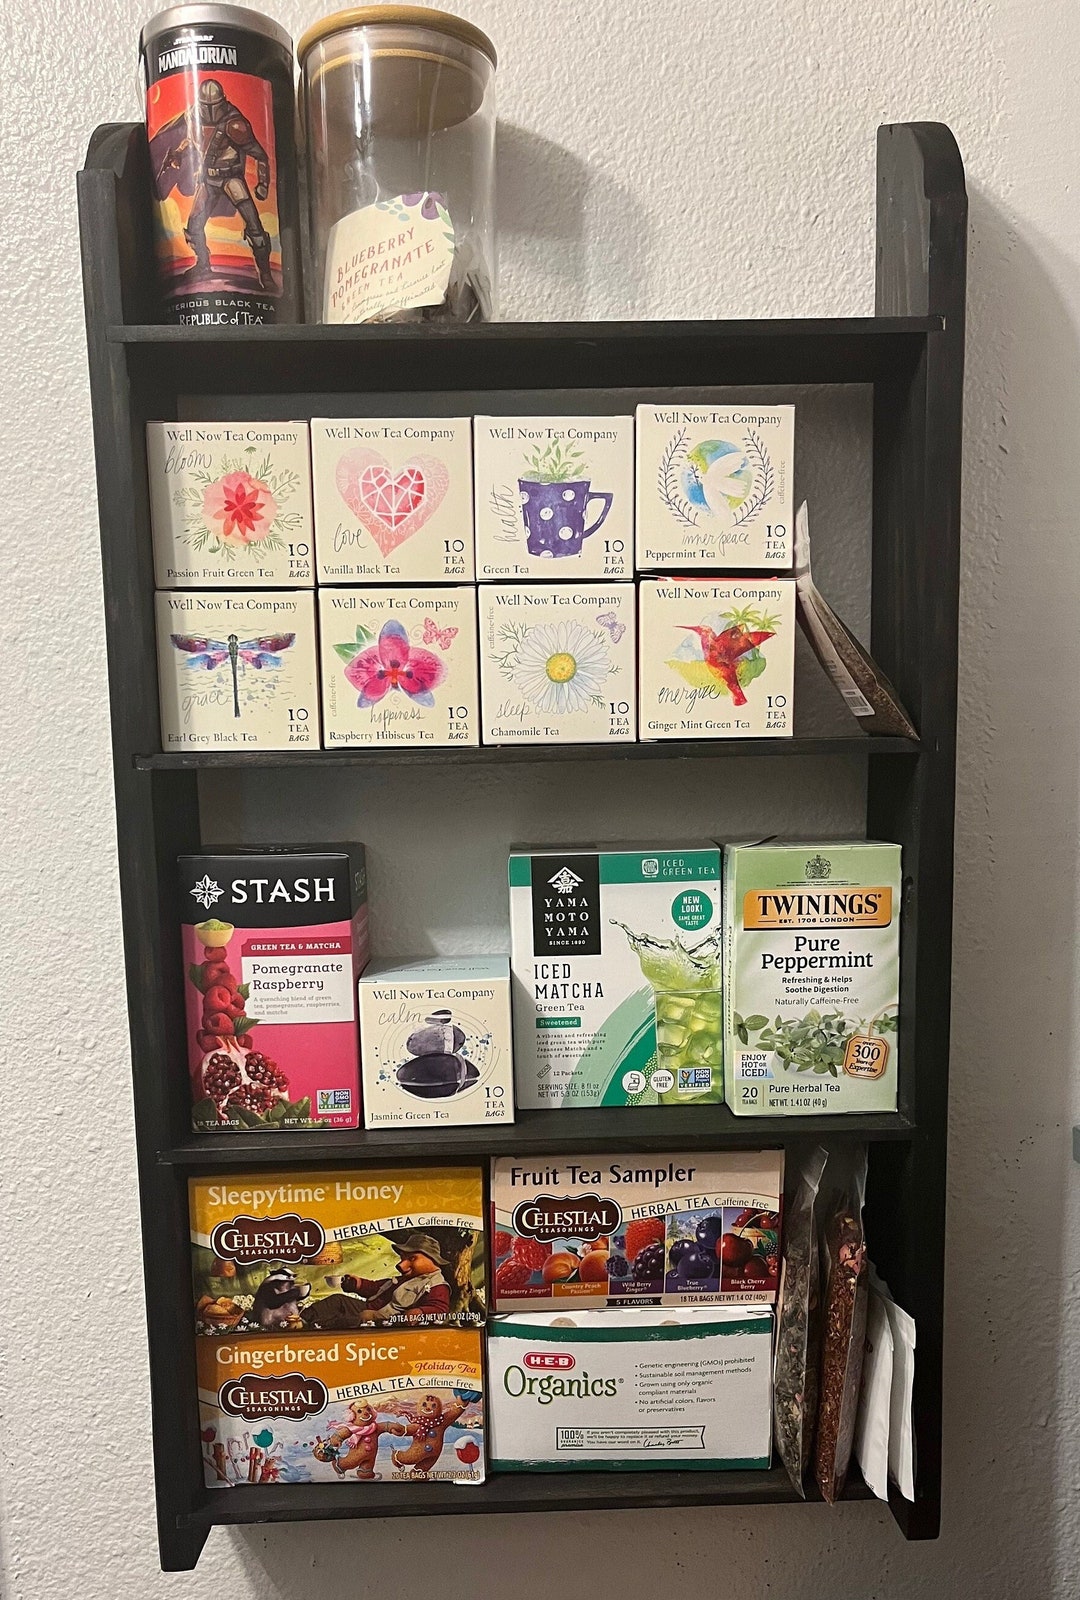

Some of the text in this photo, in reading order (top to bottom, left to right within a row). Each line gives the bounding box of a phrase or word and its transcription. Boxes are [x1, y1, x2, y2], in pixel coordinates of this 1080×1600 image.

[158, 47, 237, 73] MANDALORIAN
[337, 226, 415, 284] BLUEBERRY
[332, 239, 435, 308] POMEGRANATE
[215, 299, 275, 312] BLACK TEA
[179, 311, 263, 326] REPUBLIC of TEA
[654, 412, 782, 428] Well Now Tea Company
[167, 431, 298, 445] Well Now Tea Company
[489, 428, 618, 443] Well Now Tea Company
[164, 445, 212, 474] bloom
[333, 523, 367, 552] love
[645, 549, 716, 561] Peppermint Tea
[167, 568, 274, 578] Passion Fruit Green Tea
[323, 565, 400, 575] Vanilla Black Tea
[483, 565, 529, 574] Green Tea
[656, 588, 782, 601] Well Now Tea Company
[168, 599, 298, 613] Well Now Tea Company
[658, 683, 720, 714] energize
[491, 727, 559, 737] Chamomile Tea
[648, 720, 750, 732] Ginger Mint Green Tea
[168, 733, 257, 745] Earl Grey Black Tea
[329, 730, 434, 743] Raspberry Hibiscus Tea
[663, 859, 685, 867] ICED
[662, 868, 693, 876] GREEN
[231, 878, 335, 904] STASH
[544, 897, 589, 908] YAMA
[683, 896, 700, 904] NEW
[757, 893, 878, 916] TWININGS
[681, 904, 703, 913] LOOK!
[544, 912, 589, 922] MOTO
[545, 926, 590, 937] YAMA
[306, 942, 341, 950] MATCHA
[794, 936, 840, 952] Pure
[761, 951, 873, 973] Peppermint
[252, 963, 343, 976] Pomegranate
[534, 964, 571, 980] ICED
[253, 979, 324, 992] Raspberry
[782, 976, 823, 985] Refreshing
[831, 976, 853, 984] Helps
[373, 988, 495, 1000] Well Now Tea Company
[535, 983, 604, 1000] MATCHA
[813, 985, 849, 994] Digestion
[536, 1003, 585, 1012] Green Tea
[774, 997, 859, 1006] Naturally Caffeine-Free
[378, 1002, 423, 1025] calm
[852, 1045, 881, 1061] 300
[741, 1069, 768, 1077] ICED!
[742, 1086, 758, 1098] 20
[769, 1083, 841, 1093] Pure Herbal Tea
[370, 1111, 450, 1123] Jasmine Green Tea
[511, 1163, 696, 1188] Fruit Tea Sampler
[335, 1181, 404, 1204] Honey
[631, 1196, 769, 1220] HERBAL TEA Caffeine Free
[521, 1207, 612, 1230] CELESTIAL
[333, 1216, 474, 1240] HERBAL TEA Caffeine Free
[540, 1226, 594, 1234] SEASONINGS
[220, 1229, 315, 1252] CELESTIAL
[240, 1247, 296, 1256] SEASONINGS
[216, 1344, 339, 1369] Gingerbread
[700, 1359, 723, 1367] (GMOs)
[724, 1357, 755, 1365] prohibited
[415, 1362, 477, 1374] Holiday Tea
[686, 1369, 724, 1377] management
[337, 1377, 474, 1399] HERBAL TEA Caffeine Free
[227, 1386, 319, 1409] CELESTIAL
